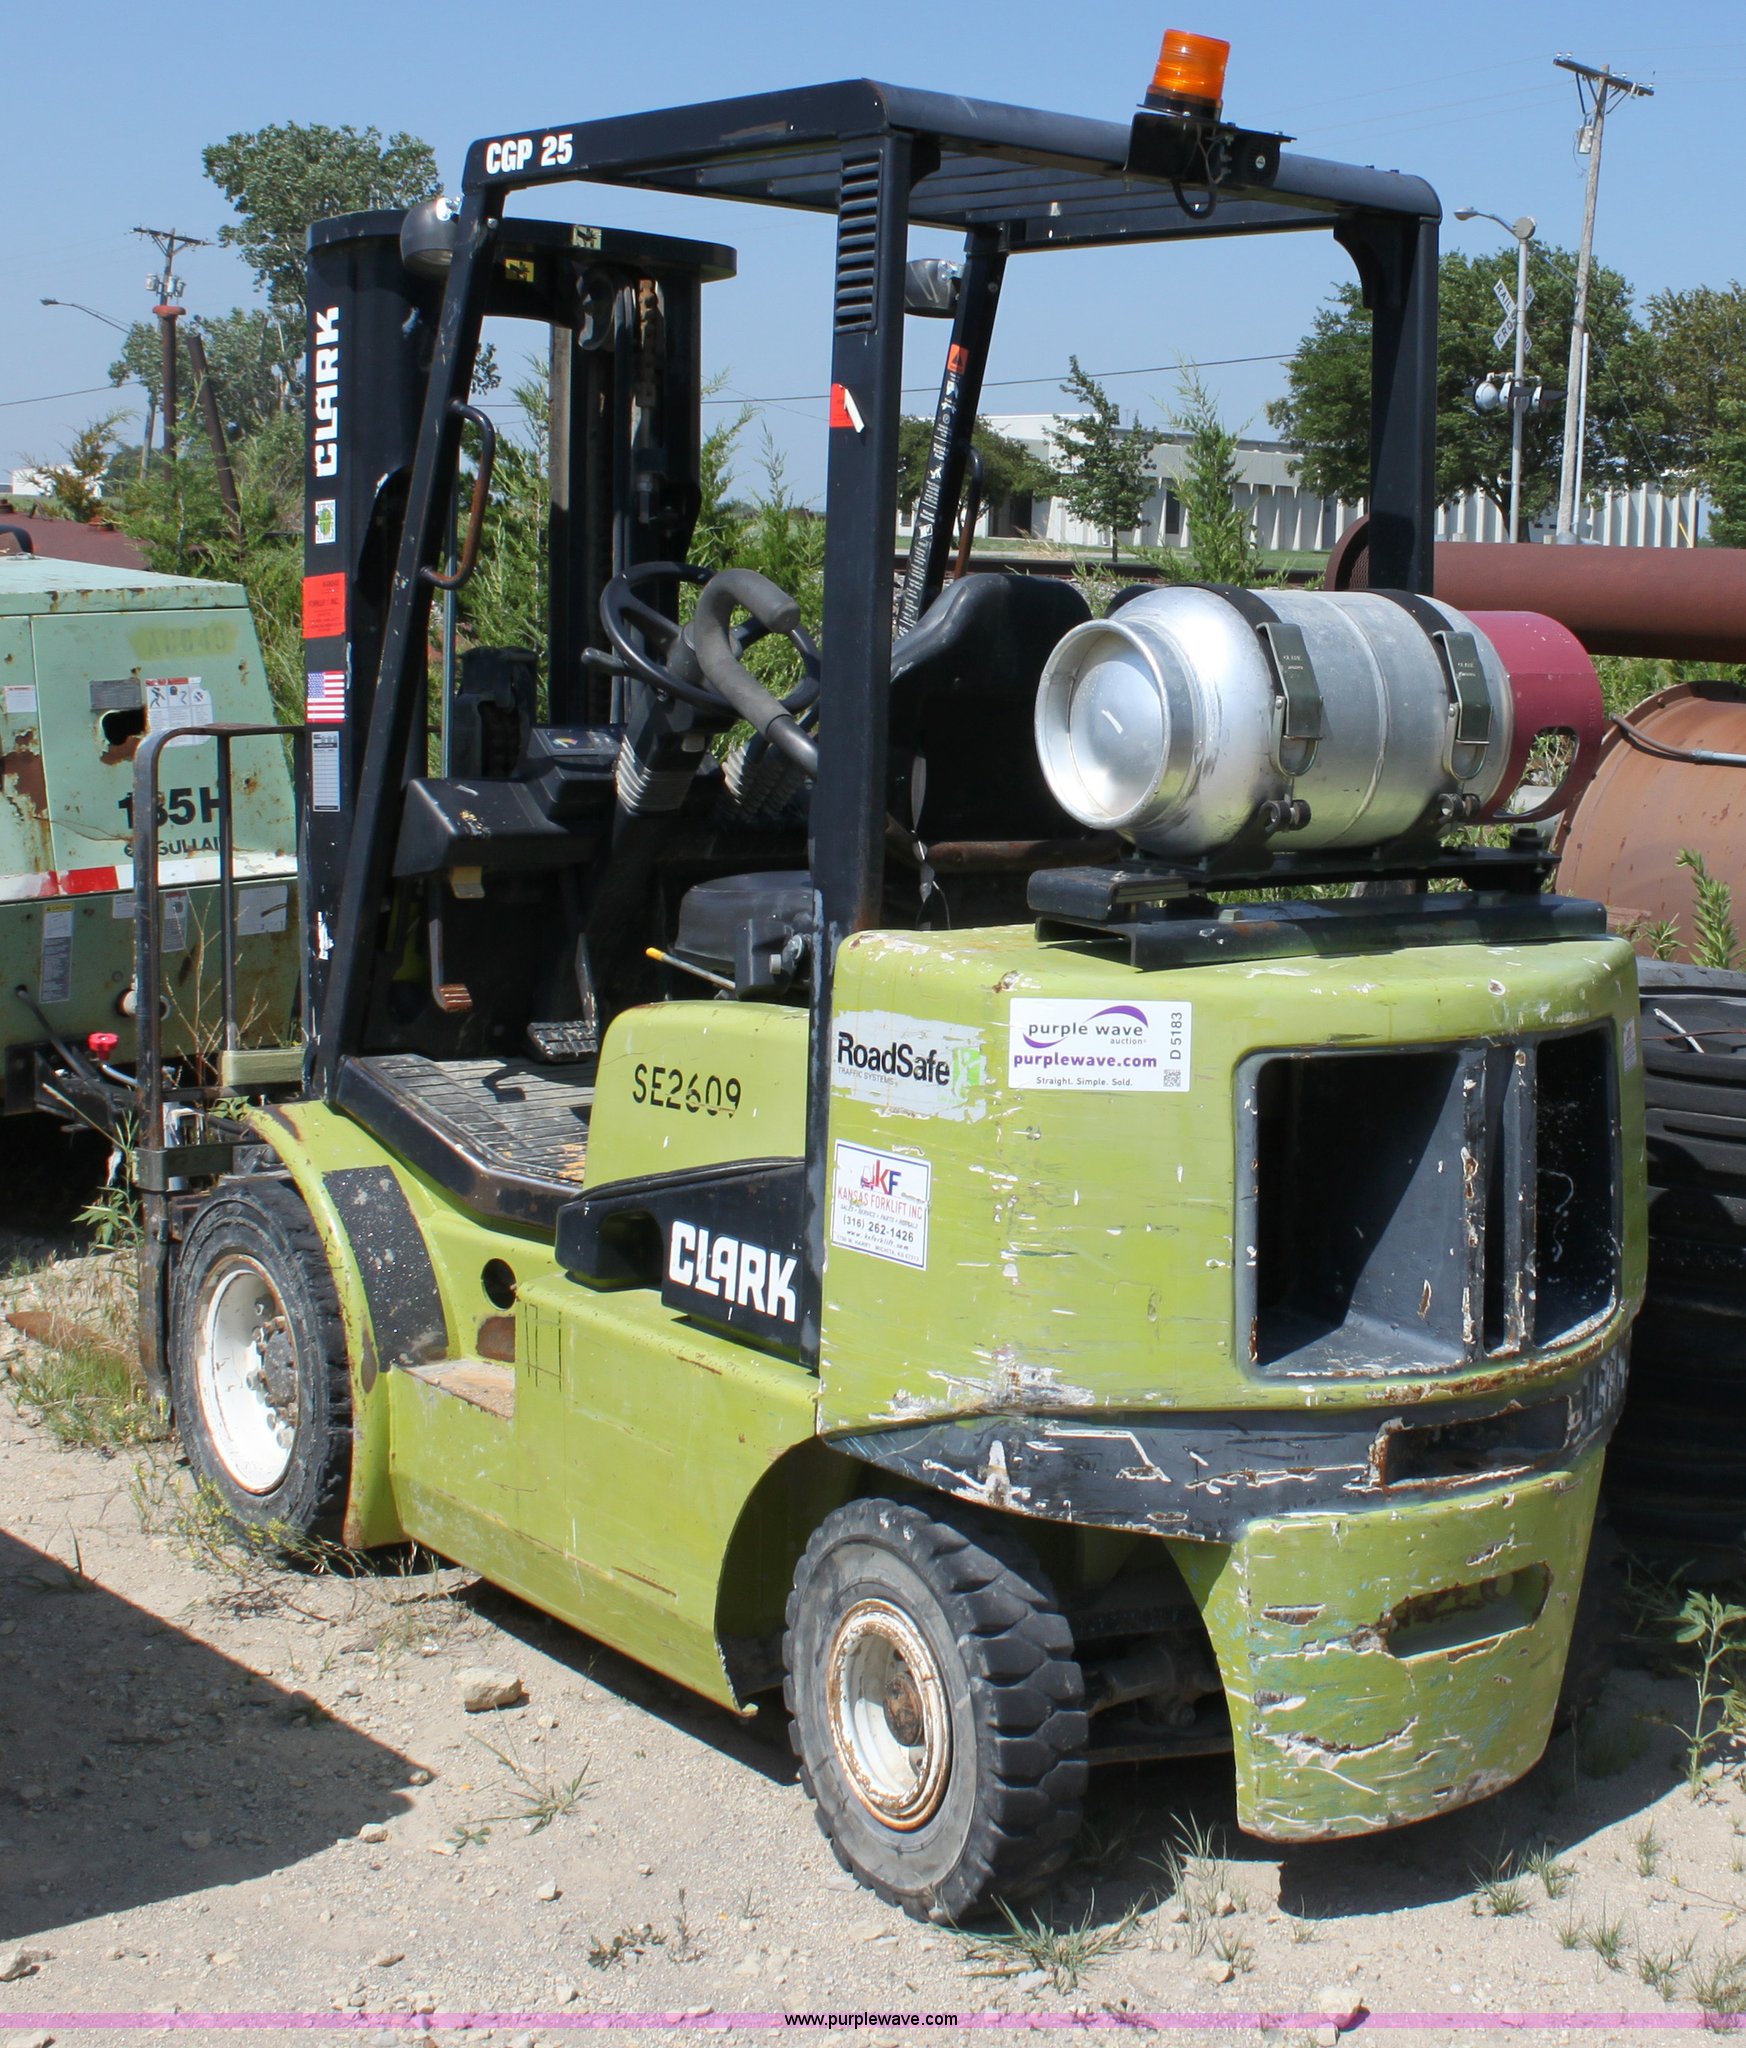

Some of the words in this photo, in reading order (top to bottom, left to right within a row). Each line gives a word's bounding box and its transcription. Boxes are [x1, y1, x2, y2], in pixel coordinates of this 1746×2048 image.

[486, 138, 533, 175] CGP
[541, 133, 573, 167] 25
[1496, 283, 1512, 312] RAIL
[1497, 289, 1533, 344] CROSG
[315, 306, 339, 478] CLARK
[157, 836, 221, 856] SULLAI
[1028, 1022, 1088, 1037] purple
[1096, 1026, 1143, 1036] wave
[1110, 1037, 1143, 1045] auction
[1171, 1012, 1182, 1046] 5183
[837, 1031, 950, 1086] RoadSafe
[1014, 1052, 1157, 1069] purplewave.com
[1170, 1050, 1181, 1060] D
[838, 1067, 863, 1079] TRAFFIC
[1036, 1076, 1073, 1085] Straight.
[1076, 1077, 1109, 1087] Simple.
[1112, 1078, 1133, 1086] Sold.
[632, 1063, 742, 1119] SE2609
[875, 1159, 902, 1195] KF
[838, 1186, 868, 1206] KANSAS
[871, 1194, 907, 1214] FORKLIFT
[909, 1204, 923, 1220] INC
[843, 1214, 865, 1229] (316)
[869, 1222, 914, 1243] 262-1426
[668, 1220, 798, 1323] CLARK
